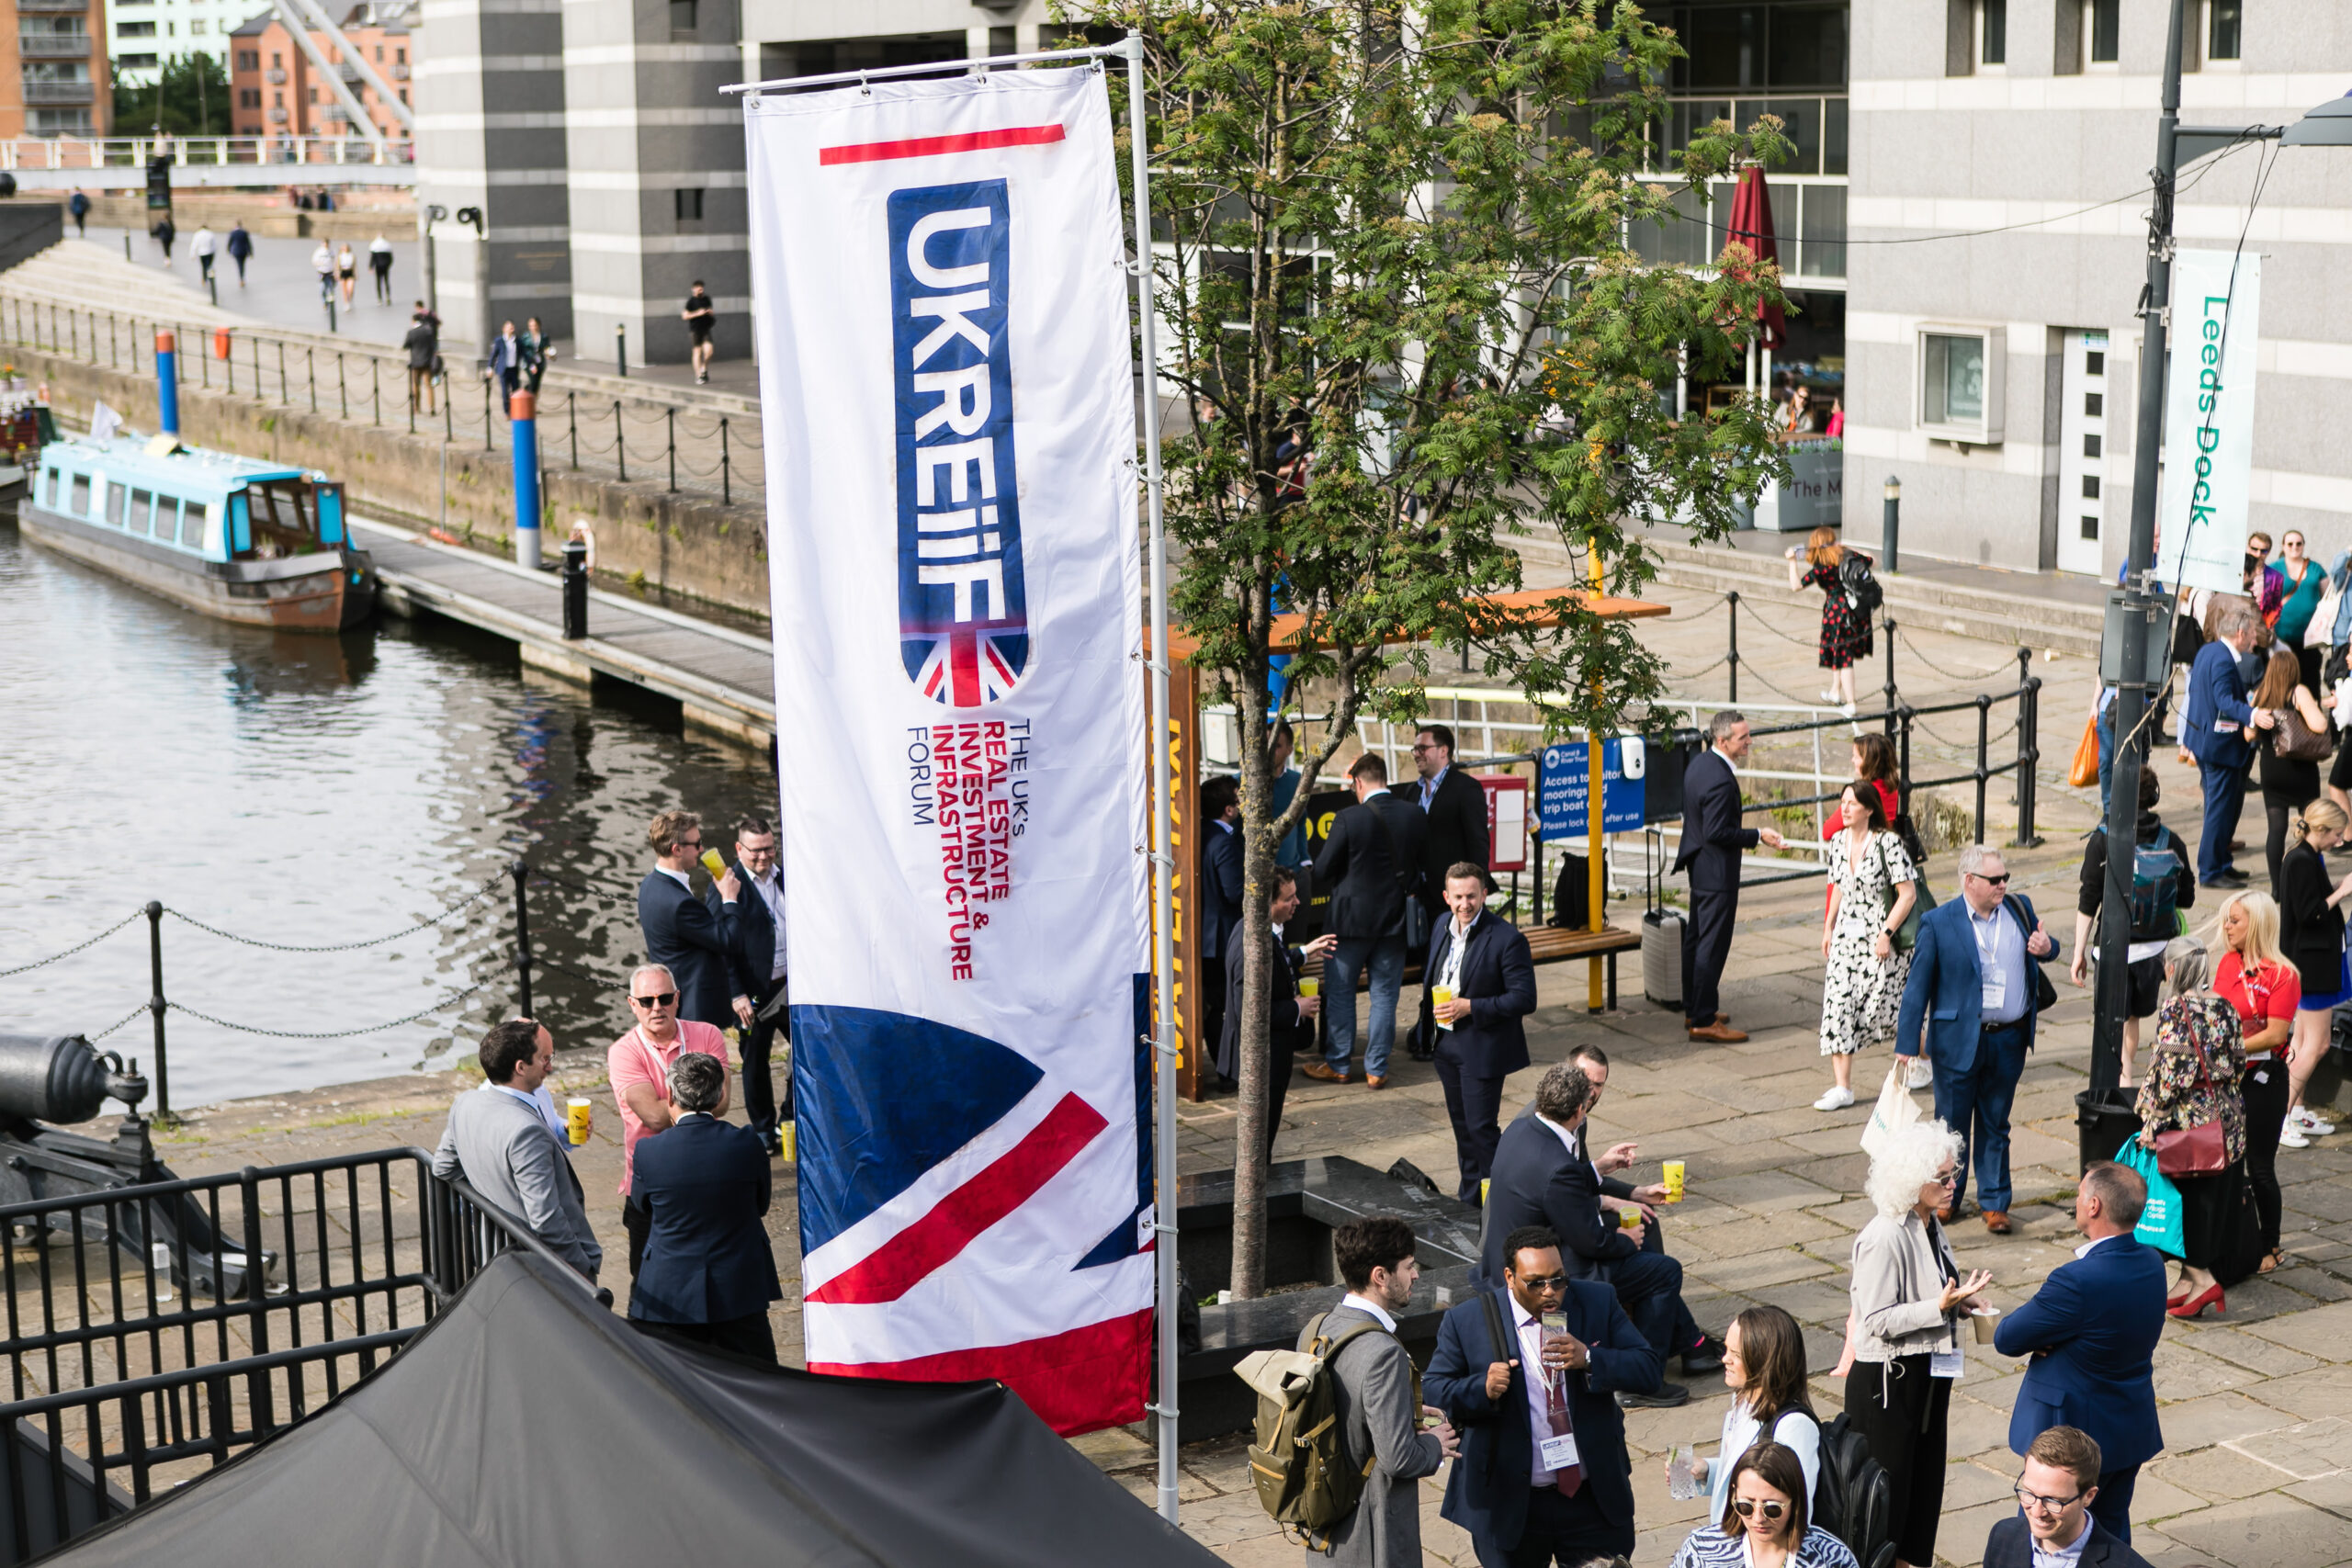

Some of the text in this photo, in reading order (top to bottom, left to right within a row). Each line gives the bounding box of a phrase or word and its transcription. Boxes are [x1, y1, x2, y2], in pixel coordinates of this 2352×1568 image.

[2198, 296, 2229, 413] Leeds
[1792, 480, 1823, 499] The
[2192, 425, 2220, 527] Dock
[907, 727, 935, 826] FORUM
[983, 721, 1010, 900] REAL ESTATE
[1010, 718, 1031, 838] THE UK's
[1544, 775, 1577, 788] Access
[1580, 773, 1589, 783] to
[1544, 787, 1589, 802] moorings
[1544, 804, 1561, 816] trip
[1563, 800, 1585, 812] boat
[1544, 819, 1567, 831] Please
[1568, 817, 1585, 828] lock
[1605, 812, 1639, 824] after use
[932, 724, 973, 981] INFRASTRUCTURE
[957, 723, 989, 931] INVESTMENT &
